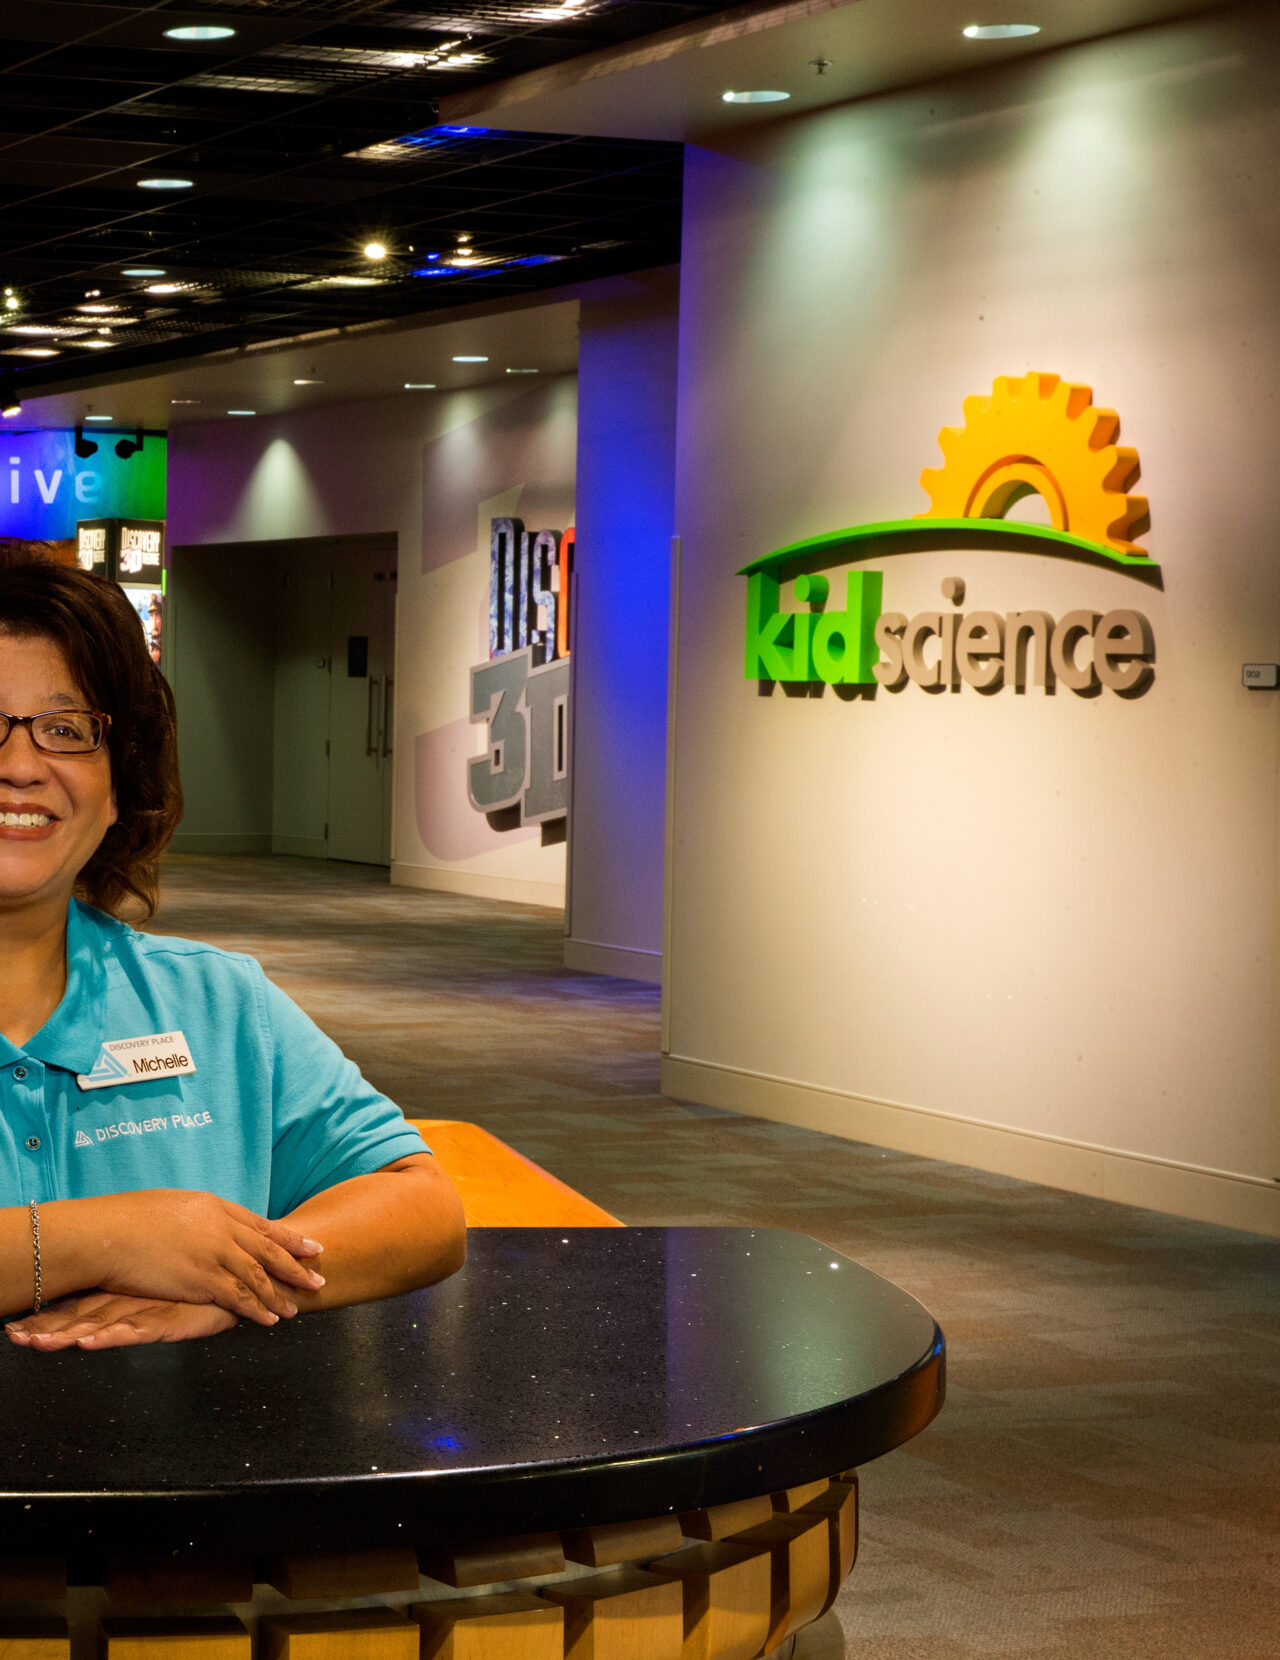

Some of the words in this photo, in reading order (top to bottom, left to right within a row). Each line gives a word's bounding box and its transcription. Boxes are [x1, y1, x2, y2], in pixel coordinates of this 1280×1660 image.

[109, 1038, 150, 1052] DISCOVERY
[151, 1035, 175, 1047] PLACE
[132, 1053, 189, 1075] Michelle
[95, 1117, 168, 1142] DISCOVERY
[171, 1111, 214, 1129] PLACE
